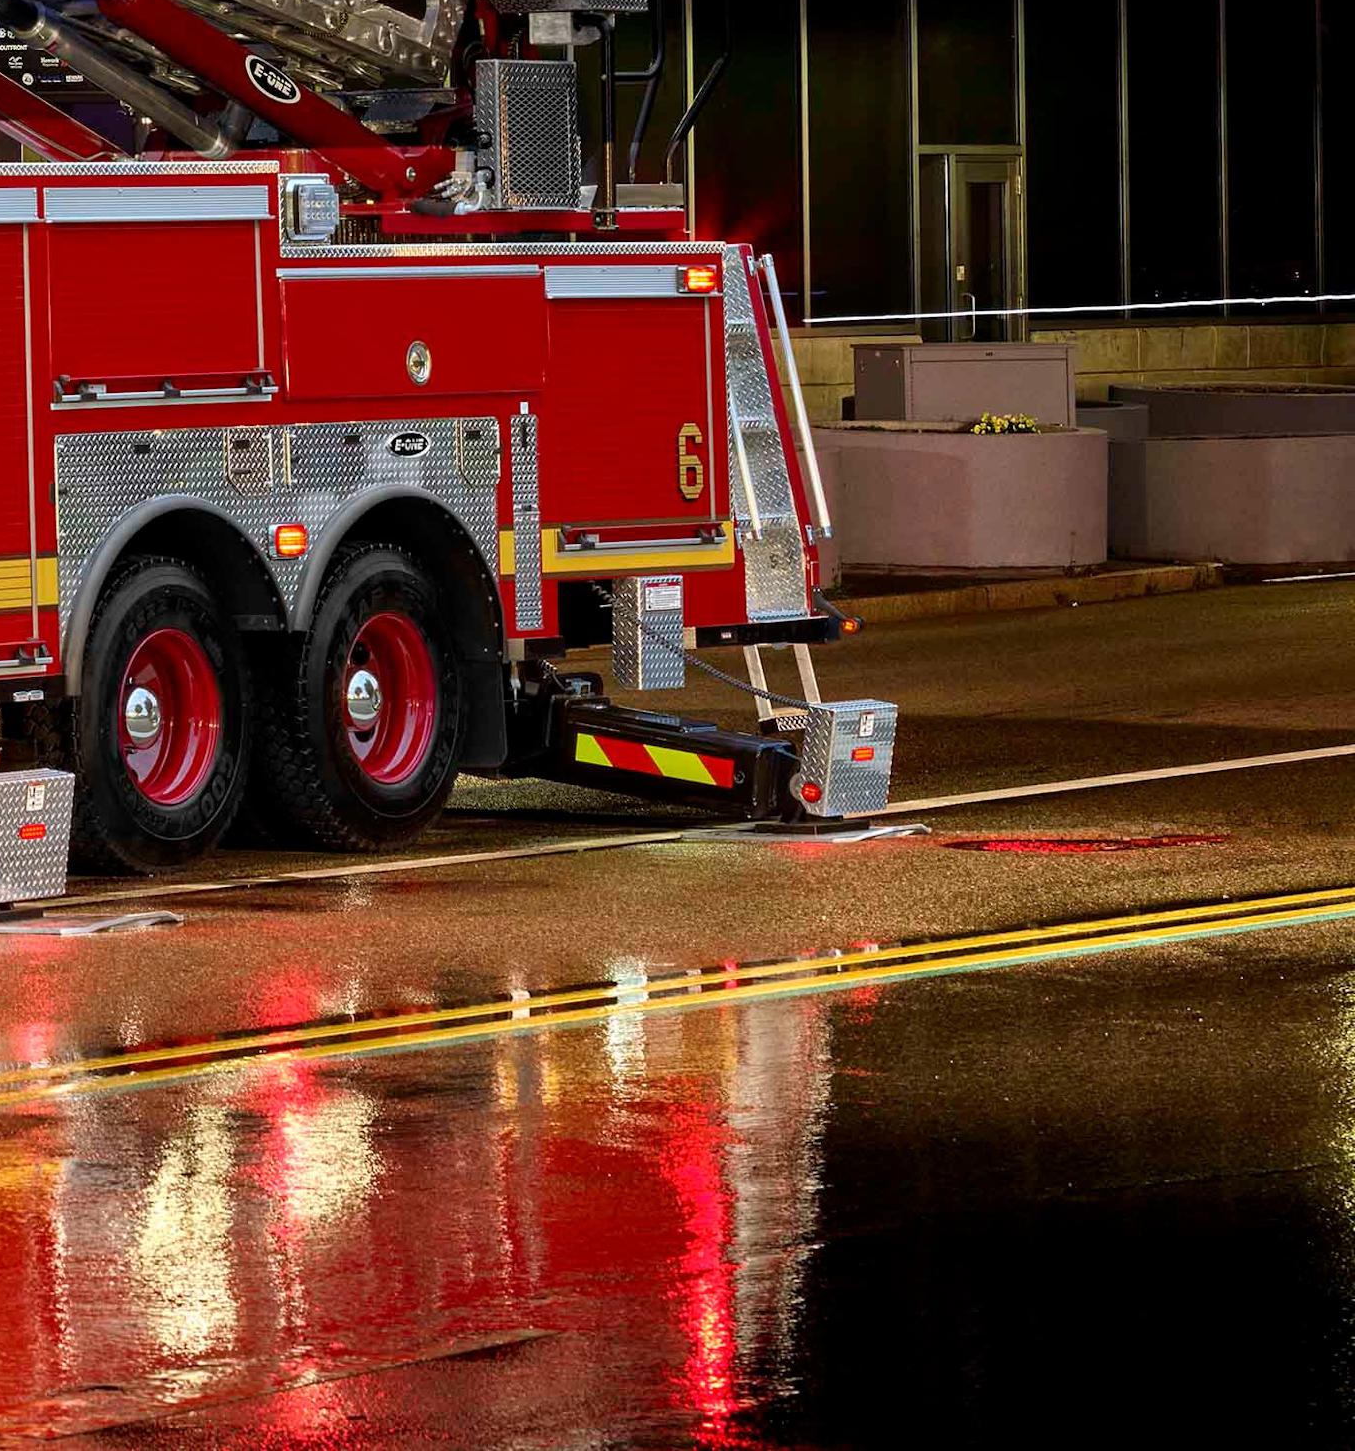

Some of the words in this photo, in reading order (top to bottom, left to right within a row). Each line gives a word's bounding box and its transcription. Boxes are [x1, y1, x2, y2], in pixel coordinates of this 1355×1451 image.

[254, 63, 292, 96] E-ONE
[395, 438, 424, 451] E-ONE
[679, 422, 704, 499] 6
